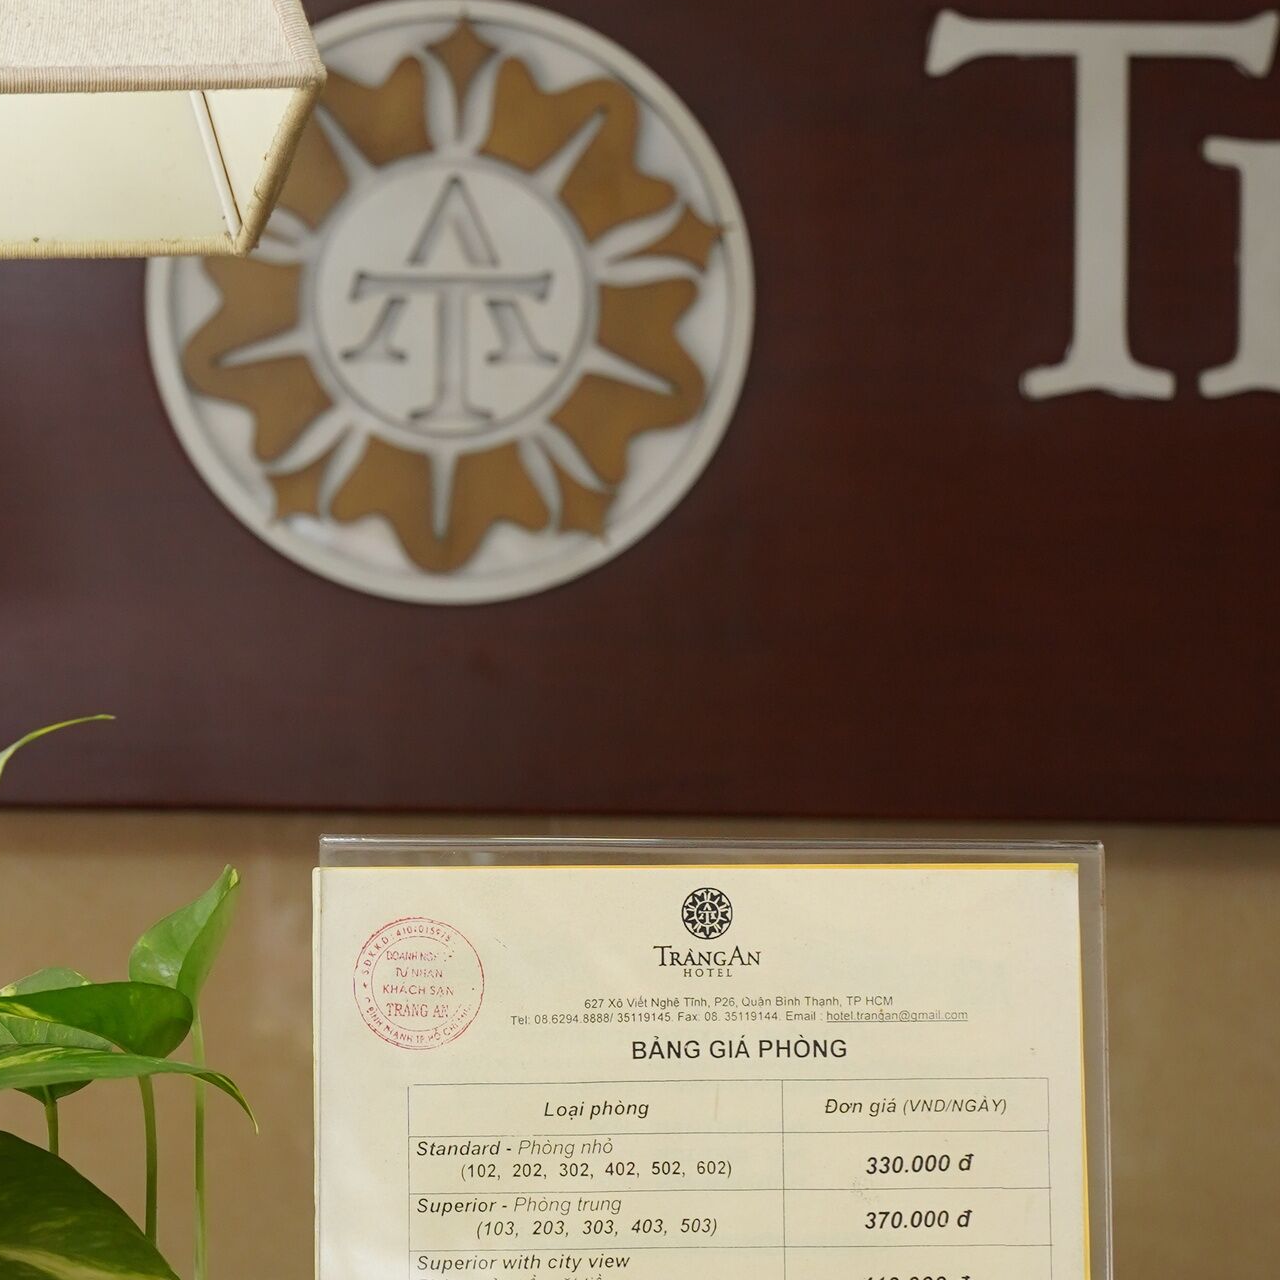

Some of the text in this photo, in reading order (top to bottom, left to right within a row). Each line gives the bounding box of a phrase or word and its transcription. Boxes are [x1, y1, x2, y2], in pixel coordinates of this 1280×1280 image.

[684, 968, 732, 977] HOTEL
[585, 999, 604, 1009] 627
[715, 997, 738, 1008] P26,
[846, 996, 861, 1005] TP
[866, 996, 893, 1006] HCM
[510, 1016, 530, 1025] Tel:
[786, 1011, 816, 1021] Email
[632, 1035, 846, 1059] BẢNG GIÁ PHÒNG
[544, 1100, 649, 1120] Loại phòng
[825, 1096, 1006, 1117] Đơn giá (VND/NGÀY)
[417, 1138, 613, 1158] Standard Phòng nhỏ
[462, 1161, 731, 1181] (102, 202, 302, 402, 502, 602)
[866, 1154, 974, 1174] 330.000 đ
[417, 1197, 621, 1216] Superior Phòng trung
[477, 1218, 716, 1239] (103, 203, 303, 403, 503)
[865, 1210, 972, 1229] 370.000 đ
[417, 1254, 630, 1274] Superior with city view
